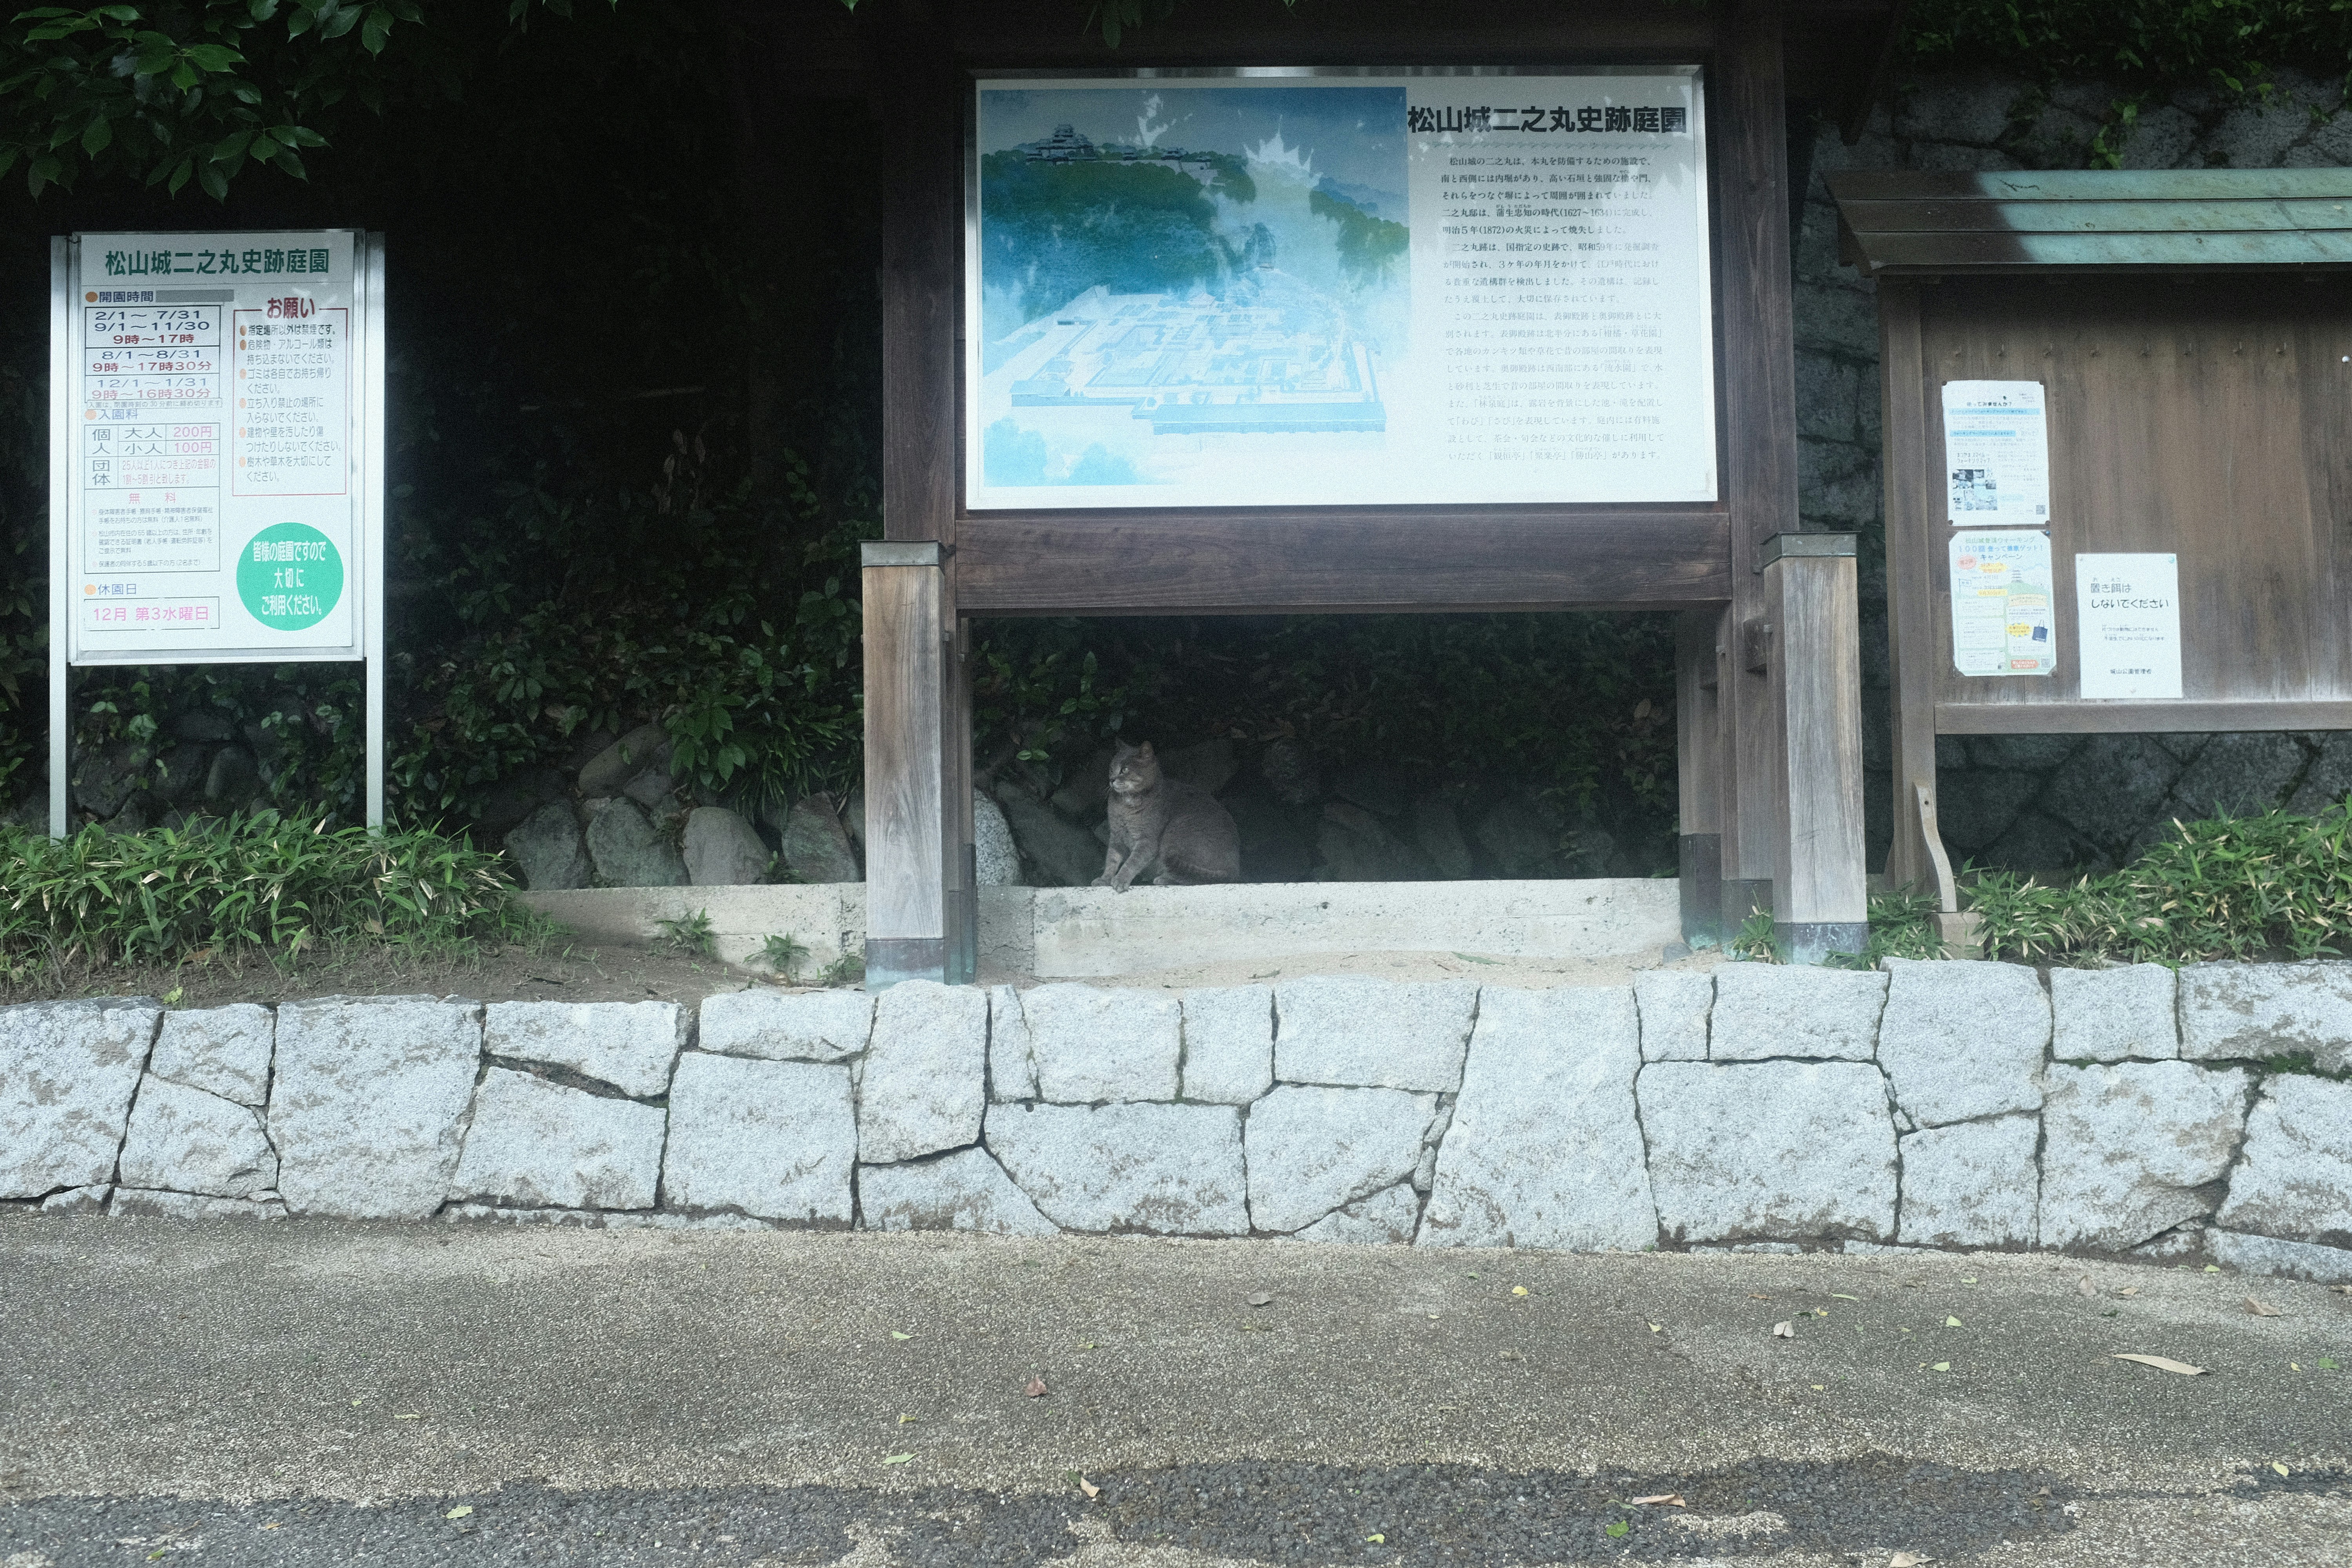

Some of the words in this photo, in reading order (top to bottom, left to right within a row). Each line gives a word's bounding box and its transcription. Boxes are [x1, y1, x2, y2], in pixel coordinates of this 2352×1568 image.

[1408, 106, 1686, 133] 松山城二之丸史跡庭園
[105, 248, 329, 275] 松山城二之丸史跡庭園
[99, 291, 154, 303] 開園時間
[267, 297, 315, 319] お願い
[249, 324, 335, 336] 指定場所以外は禁煙です。
[248, 339, 332, 351] 危険物・アルコール類は
[247, 354, 335, 365] 持ち込まないでください。
[247, 368, 331, 379] ゴミは各自でお持ち帰り
[247, 383, 280, 394] ください。
[247, 397, 324, 409] 立ち入り禁止の場所に
[98, 408, 138, 420] 入園料
[246, 412, 319, 424] 入らないでください。
[125, 427, 163, 439] 大人
[173, 426, 212, 438] 200円
[247, 426, 324, 438] 建物や壁を汚したり傷
[125, 443, 163, 455] 小人
[174, 442, 212, 453] 100円
[246, 441, 341, 453] つけたりしないでください。
[247, 455, 331, 468] 樹木や草木を大切にして
[246, 470, 280, 482] ください。
[253, 541, 327, 562] 皆様の庭園ですので
[274, 568, 305, 588] 大切に
[97, 583, 137, 595] 休園日
[2090, 583, 2132, 593] 置き餌は
[261, 595, 322, 615] ご利用ください。
[2091, 599, 2169, 609] しないでください
[93, 607, 127, 621] 12月
[136, 606, 209, 621] 第3水曜日
